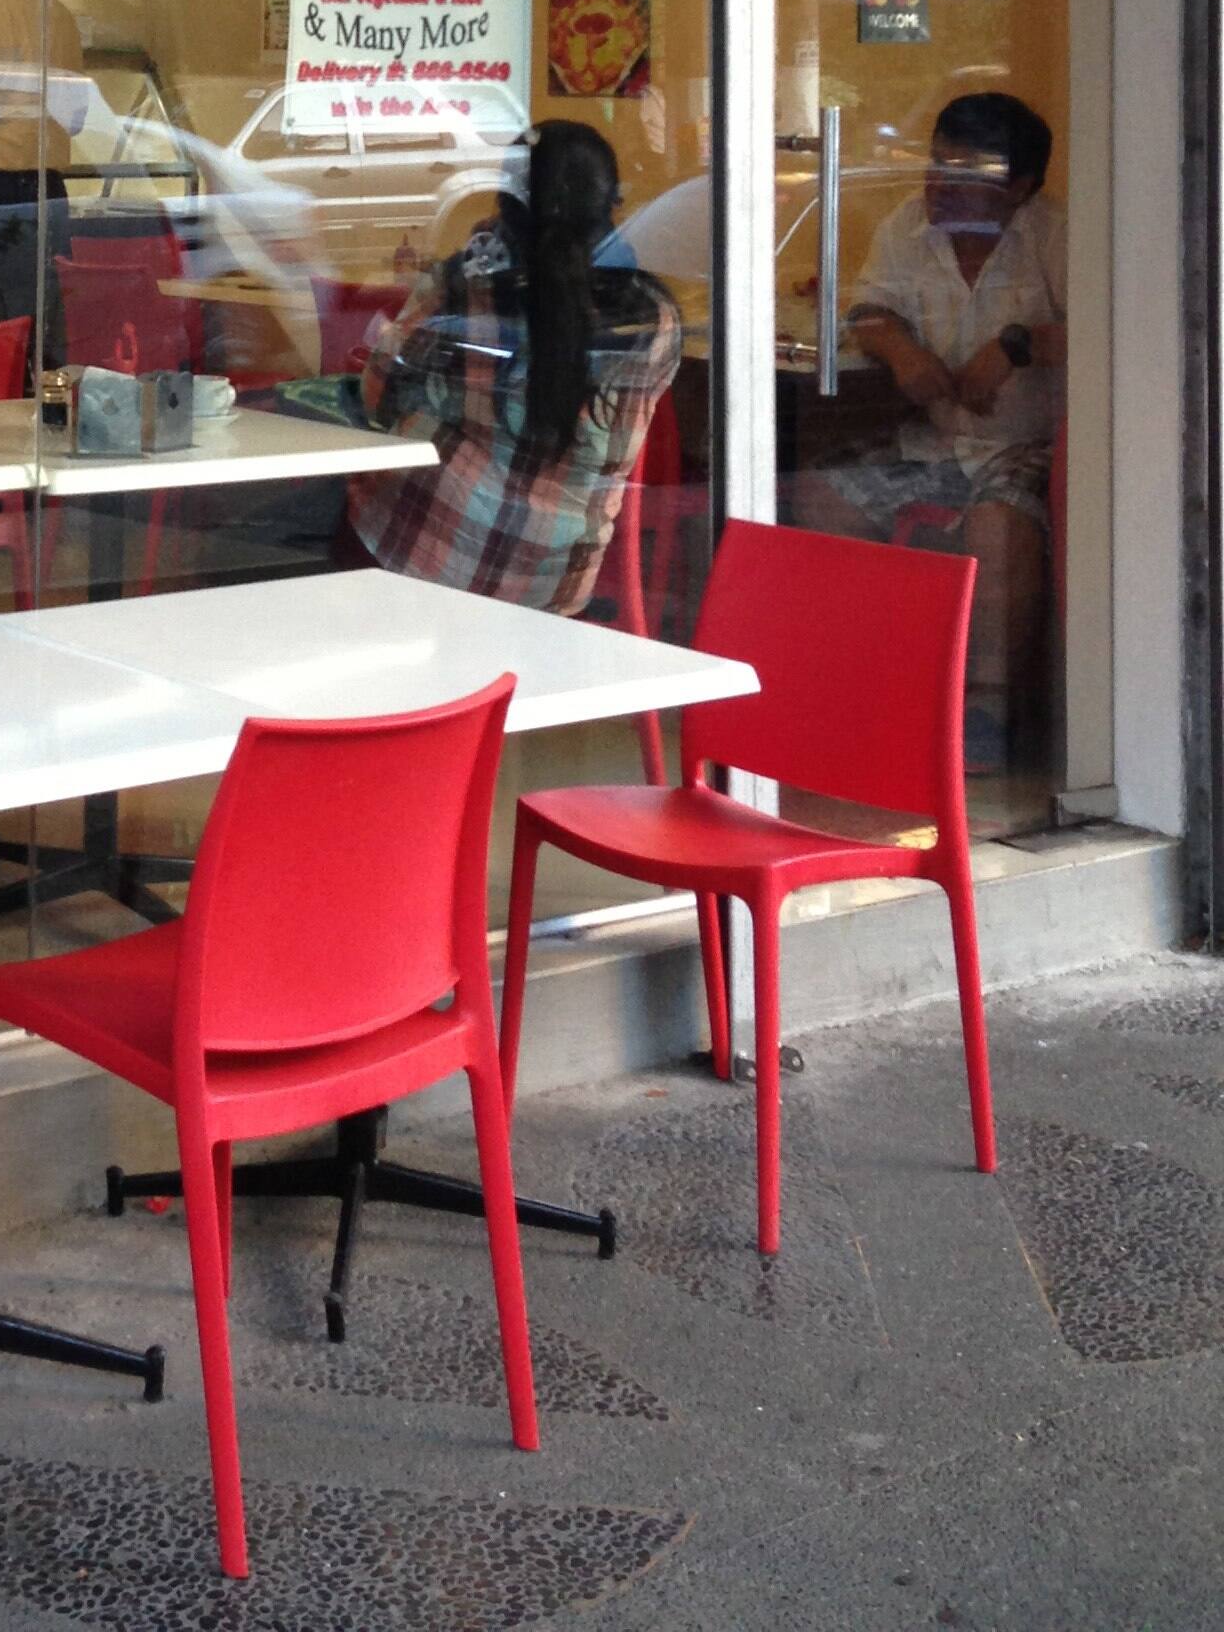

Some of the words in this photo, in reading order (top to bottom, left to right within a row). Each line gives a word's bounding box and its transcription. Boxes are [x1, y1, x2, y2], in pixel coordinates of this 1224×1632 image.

[304, 2, 326, 42] &
[334, 11, 411, 60] Many
[419, 11, 489, 50] More
[297, 60, 381, 87] Delivery
[380, 96, 414, 117] the
